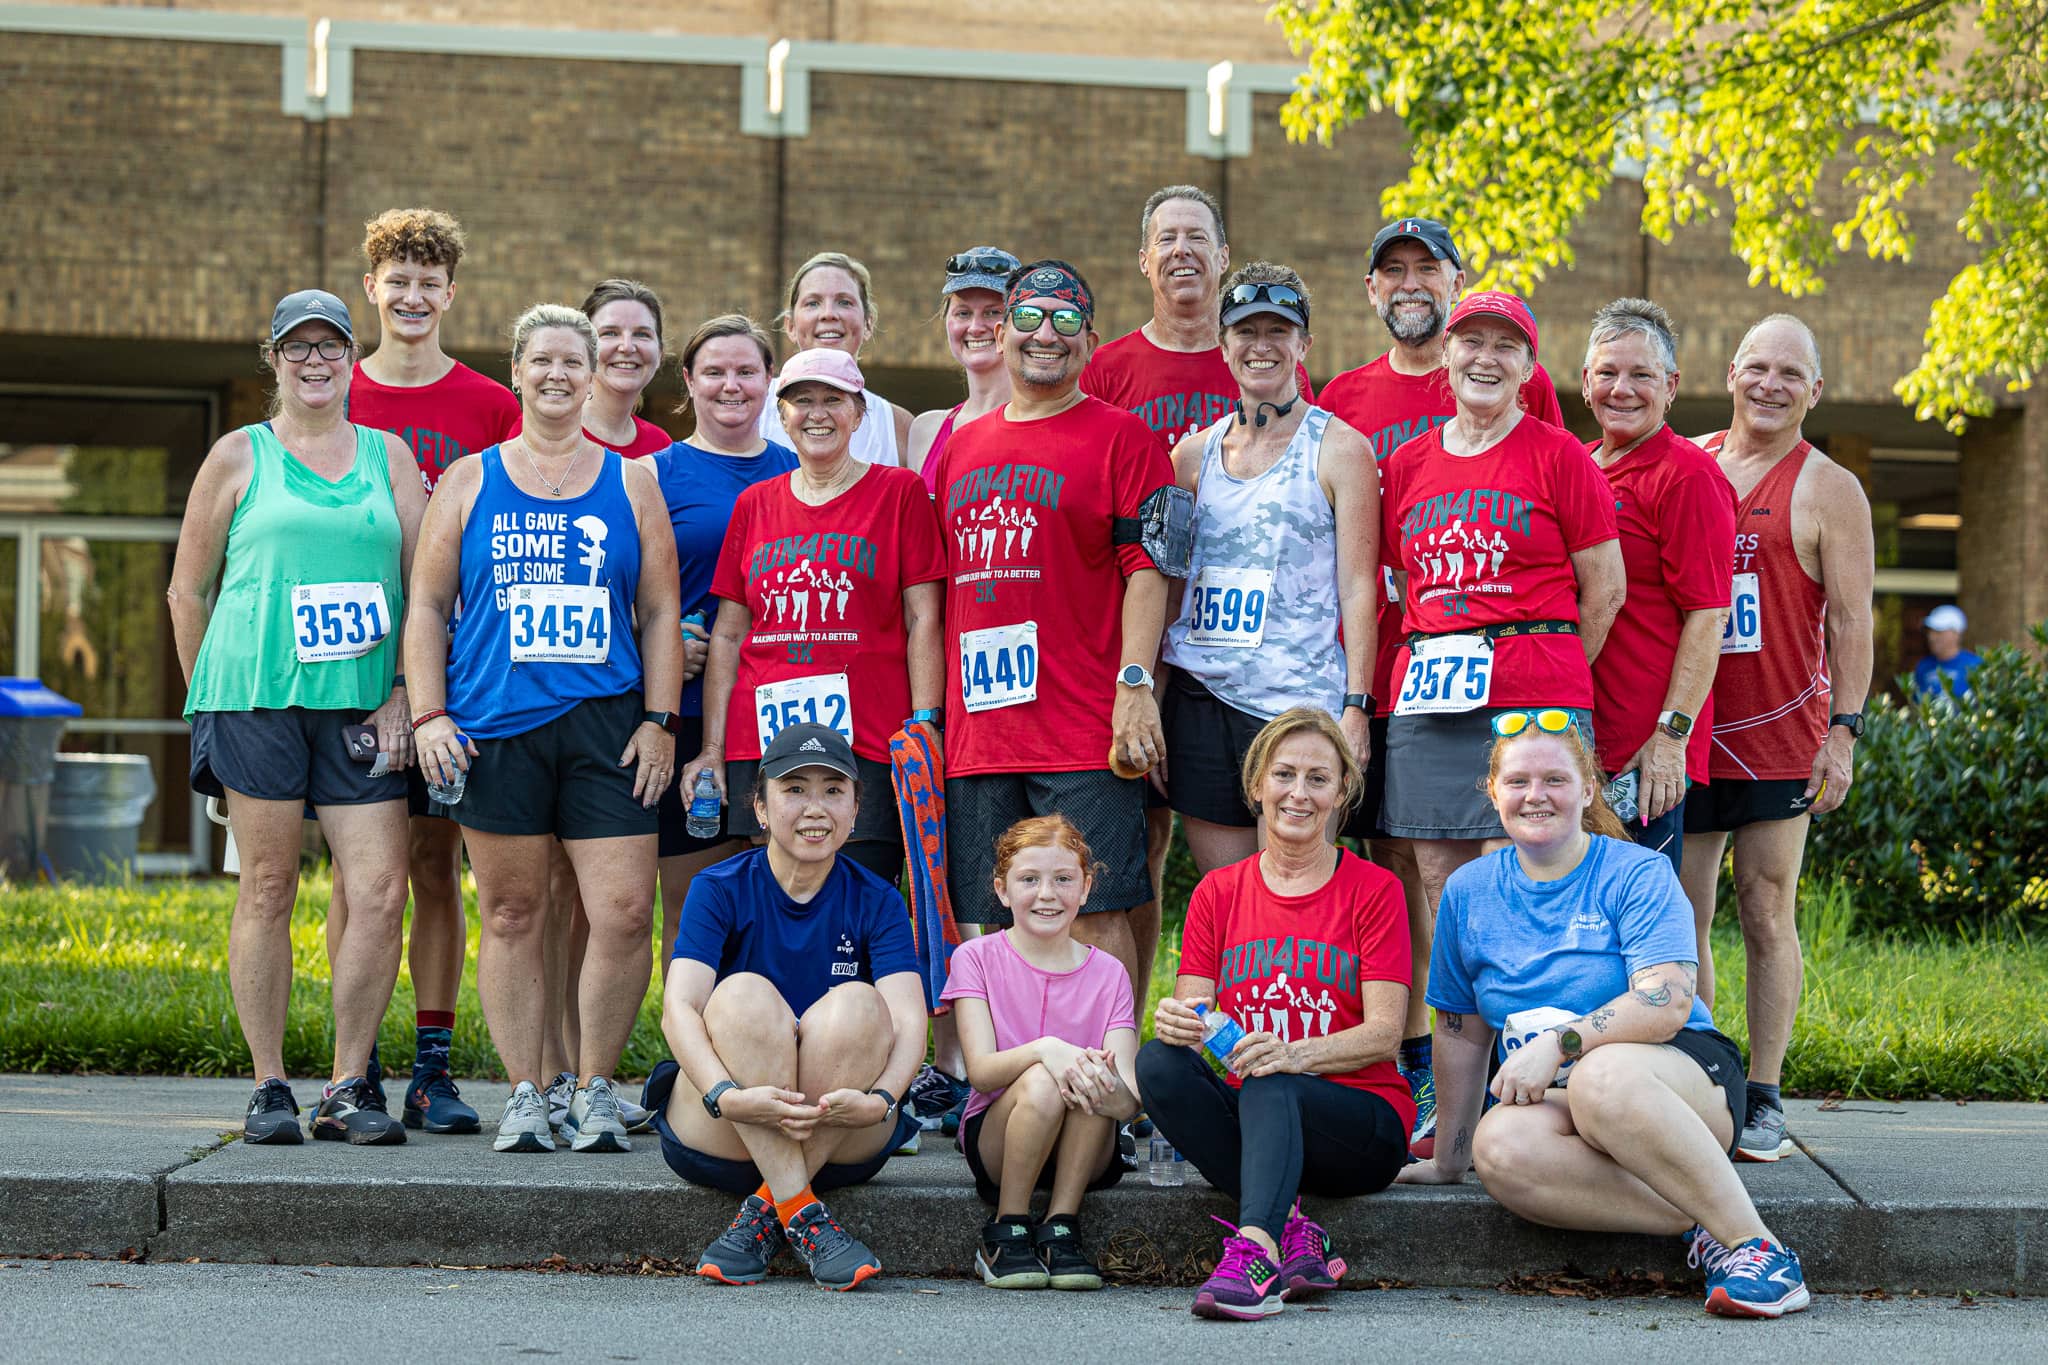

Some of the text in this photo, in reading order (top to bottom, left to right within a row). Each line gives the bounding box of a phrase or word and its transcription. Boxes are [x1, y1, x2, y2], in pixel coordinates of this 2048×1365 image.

[946, 463, 1066, 521] RUN4FUN
[492, 512, 568, 534] ALL GAVE
[1401, 488, 1535, 545] RUN4FUN
[491, 533, 566, 560] SOME
[748, 532, 878, 587] RUN4FUN
[493, 562, 565, 584] BUT SOME
[994, 570, 1003, 579] TO
[1003, 570, 1009, 579] A
[1010, 569, 1041, 579] BETTER
[1482, 583, 1512, 593] BETTER
[297, 601, 386, 648] 3531
[514, 604, 608, 648] 3454
[1191, 586, 1265, 633] 3599
[751, 632, 858, 644] MAKING OUR WAY TO A BETTER
[962, 644, 1036, 698] 3440
[1402, 656, 1489, 701] 3575
[761, 693, 849, 747] 3512
[1217, 936, 1360, 996] RUN4FUN
